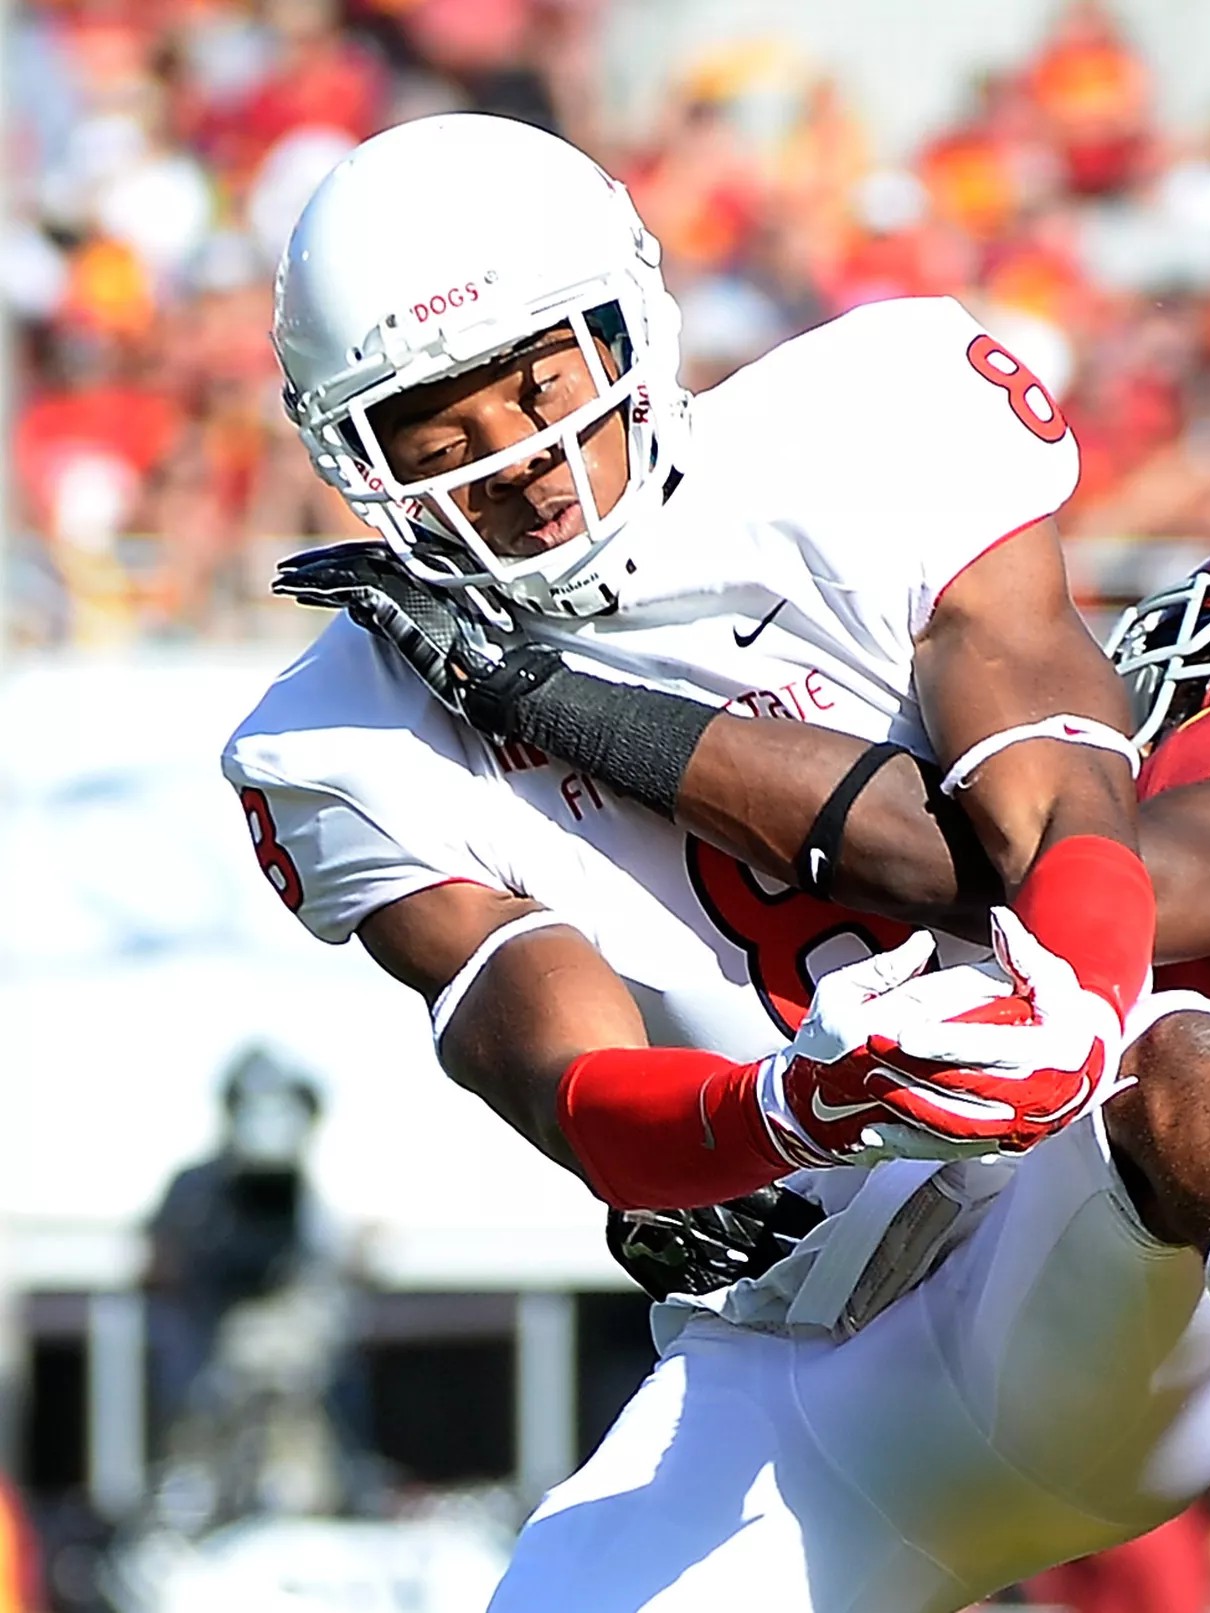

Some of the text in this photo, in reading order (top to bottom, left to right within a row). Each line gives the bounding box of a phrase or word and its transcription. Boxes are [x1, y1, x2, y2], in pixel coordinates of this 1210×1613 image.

[966, 334, 1068, 444] 8
[240, 786, 304, 914] 8
[685, 832, 942, 1042] 8
